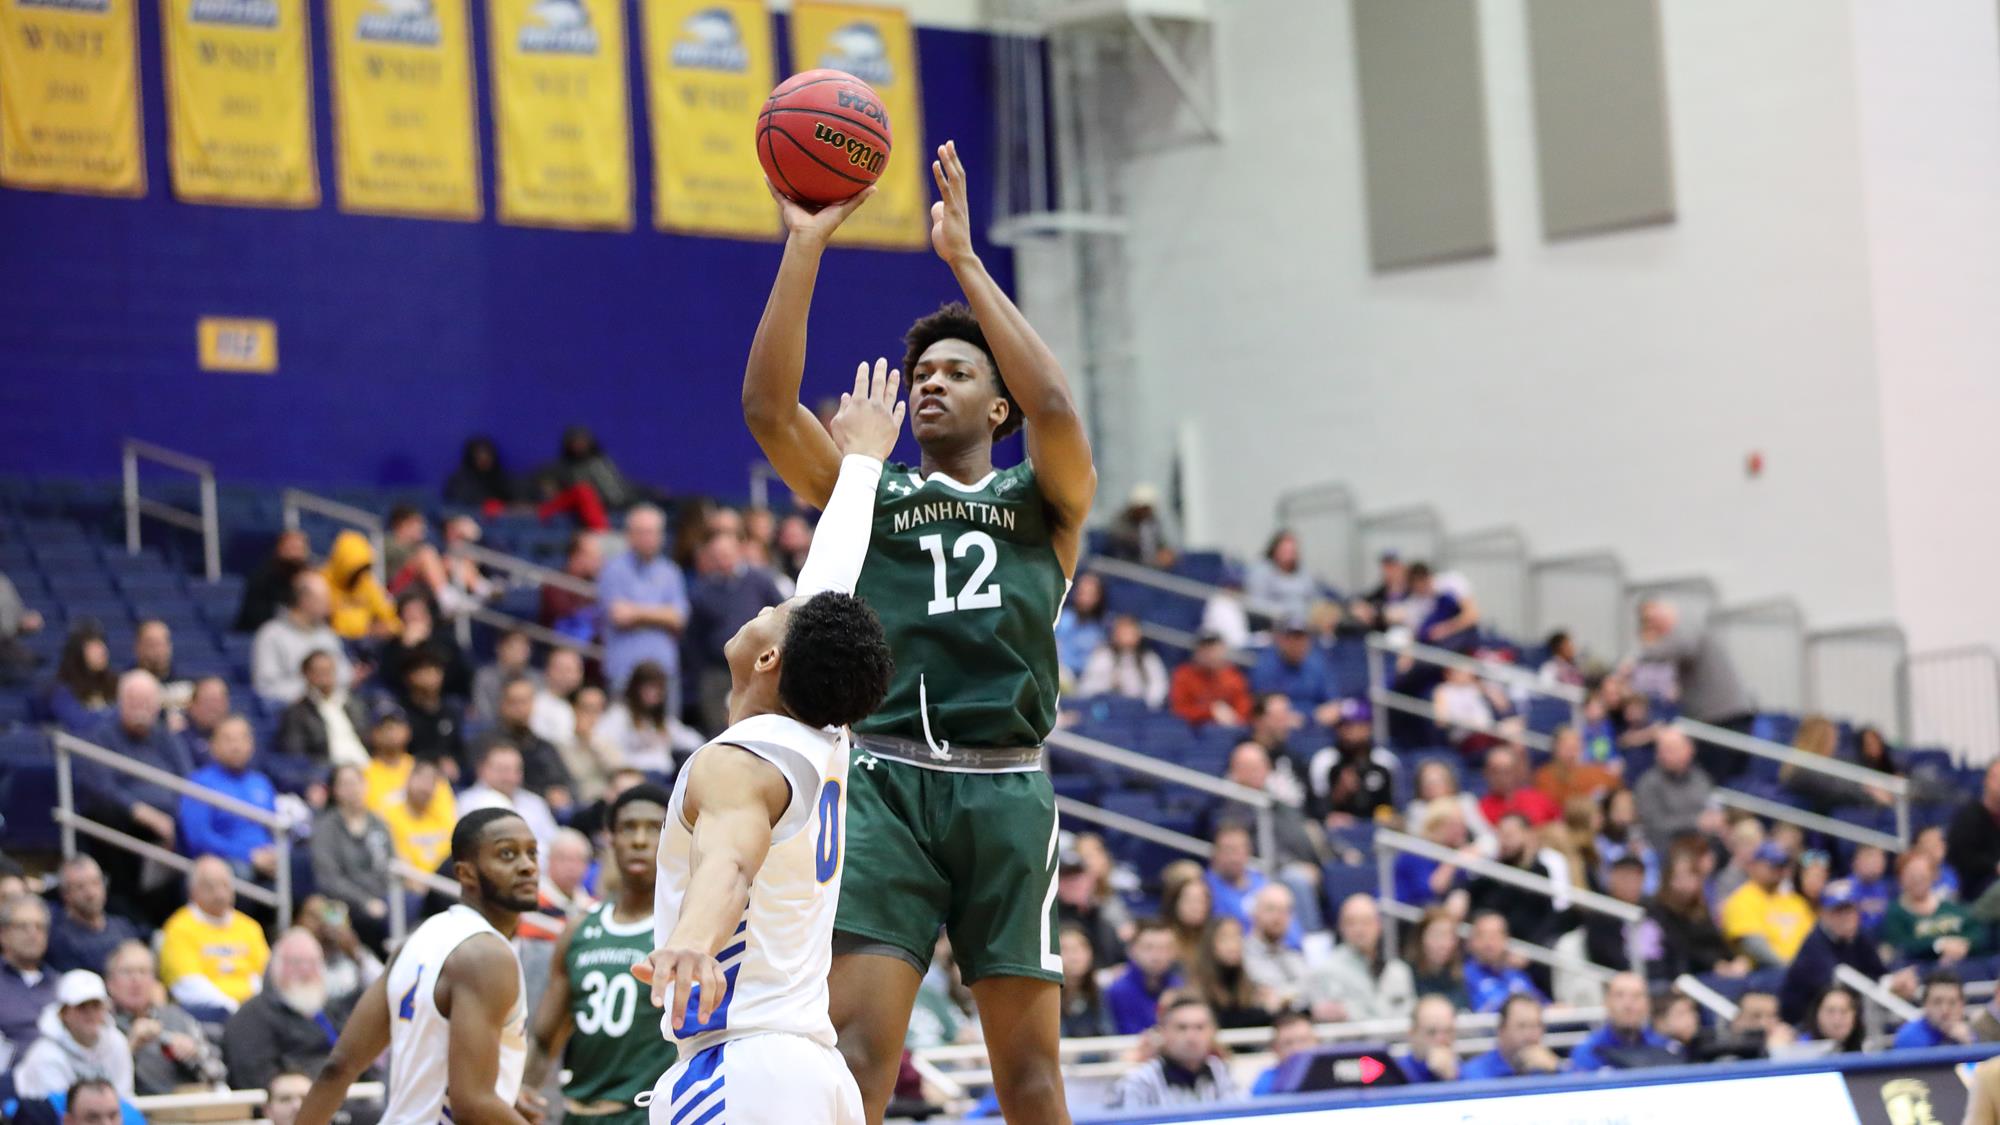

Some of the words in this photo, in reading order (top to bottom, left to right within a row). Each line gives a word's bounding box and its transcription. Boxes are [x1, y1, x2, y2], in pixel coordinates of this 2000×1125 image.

[837, 90, 889, 130] NCAA
[814, 122, 886, 176] Wilson
[894, 501, 1015, 534] MANHATTAN
[918, 529, 1002, 616] 12
[815, 776, 842, 886] 0
[575, 970, 639, 1038] 30
